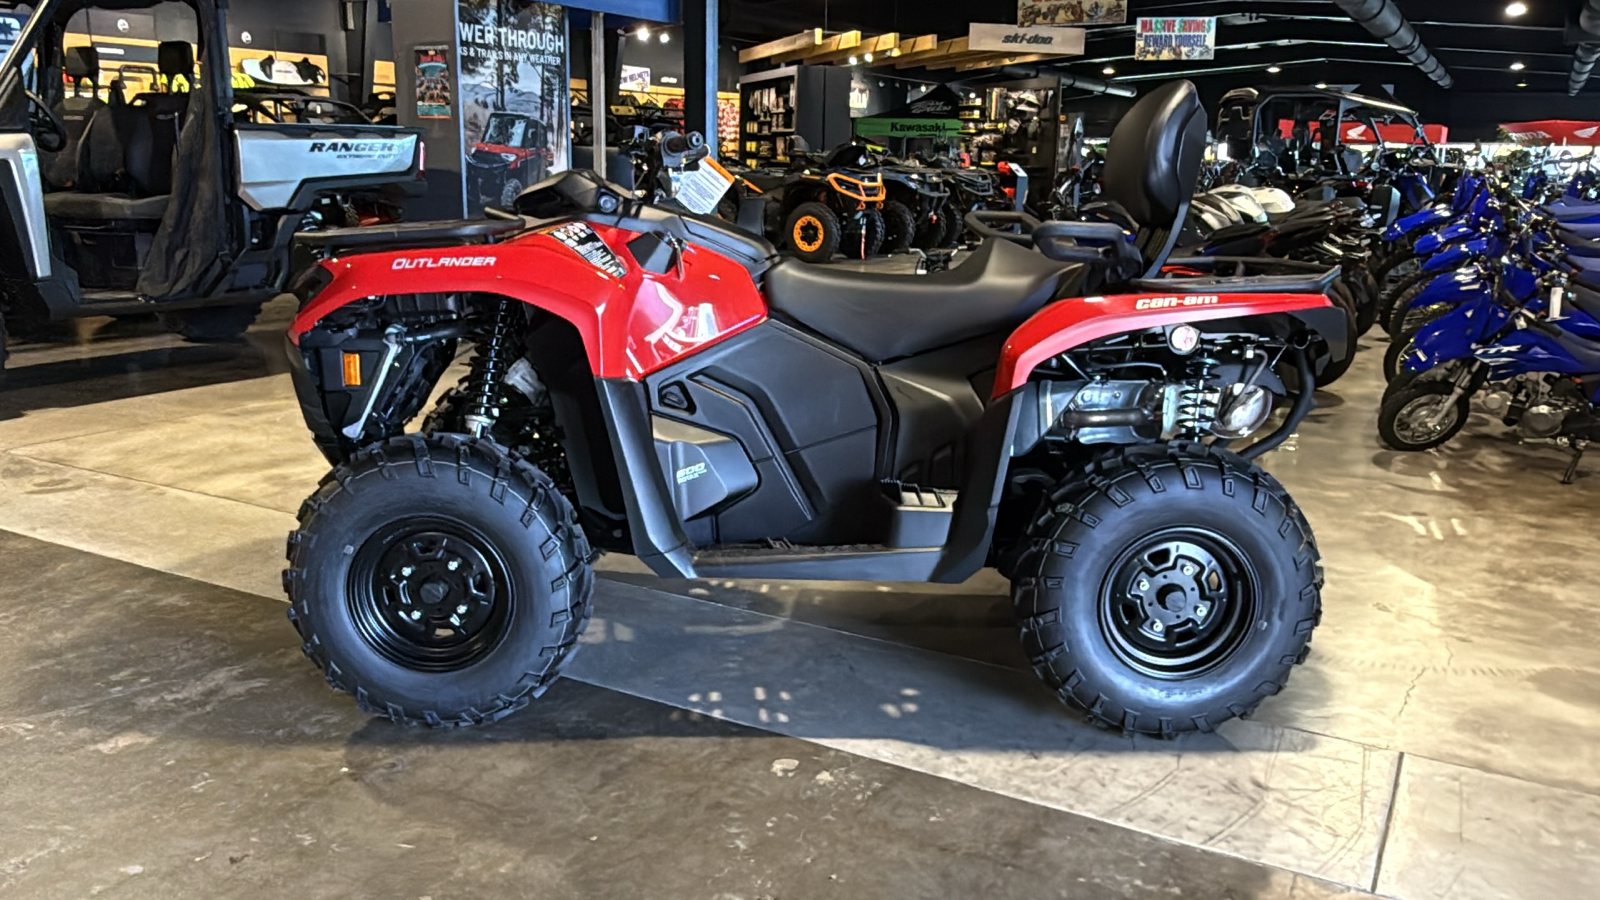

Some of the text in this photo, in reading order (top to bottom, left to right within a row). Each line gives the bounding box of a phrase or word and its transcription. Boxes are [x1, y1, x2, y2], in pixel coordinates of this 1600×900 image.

[1141, 18, 1213, 33] MASSIVE SAVINGS
[498, 26, 564, 53] THROUGH
[1002, 33, 1053, 45] ski-doo
[1144, 34, 1173, 47] REWARD
[1175, 34, 1207, 47] YOURSELF
[469, 47, 475, 57] &
[477, 48, 503, 60] TRAILS
[505, 51, 512, 61] IN
[514, 52, 528, 62] ANY
[530, 54, 561, 66] WEATHER
[890, 122, 945, 132] Kawasaki
[309, 142, 394, 153] RANGER
[391, 257, 497, 270] OUTLANDER
[1135, 295, 1219, 310] can-am
